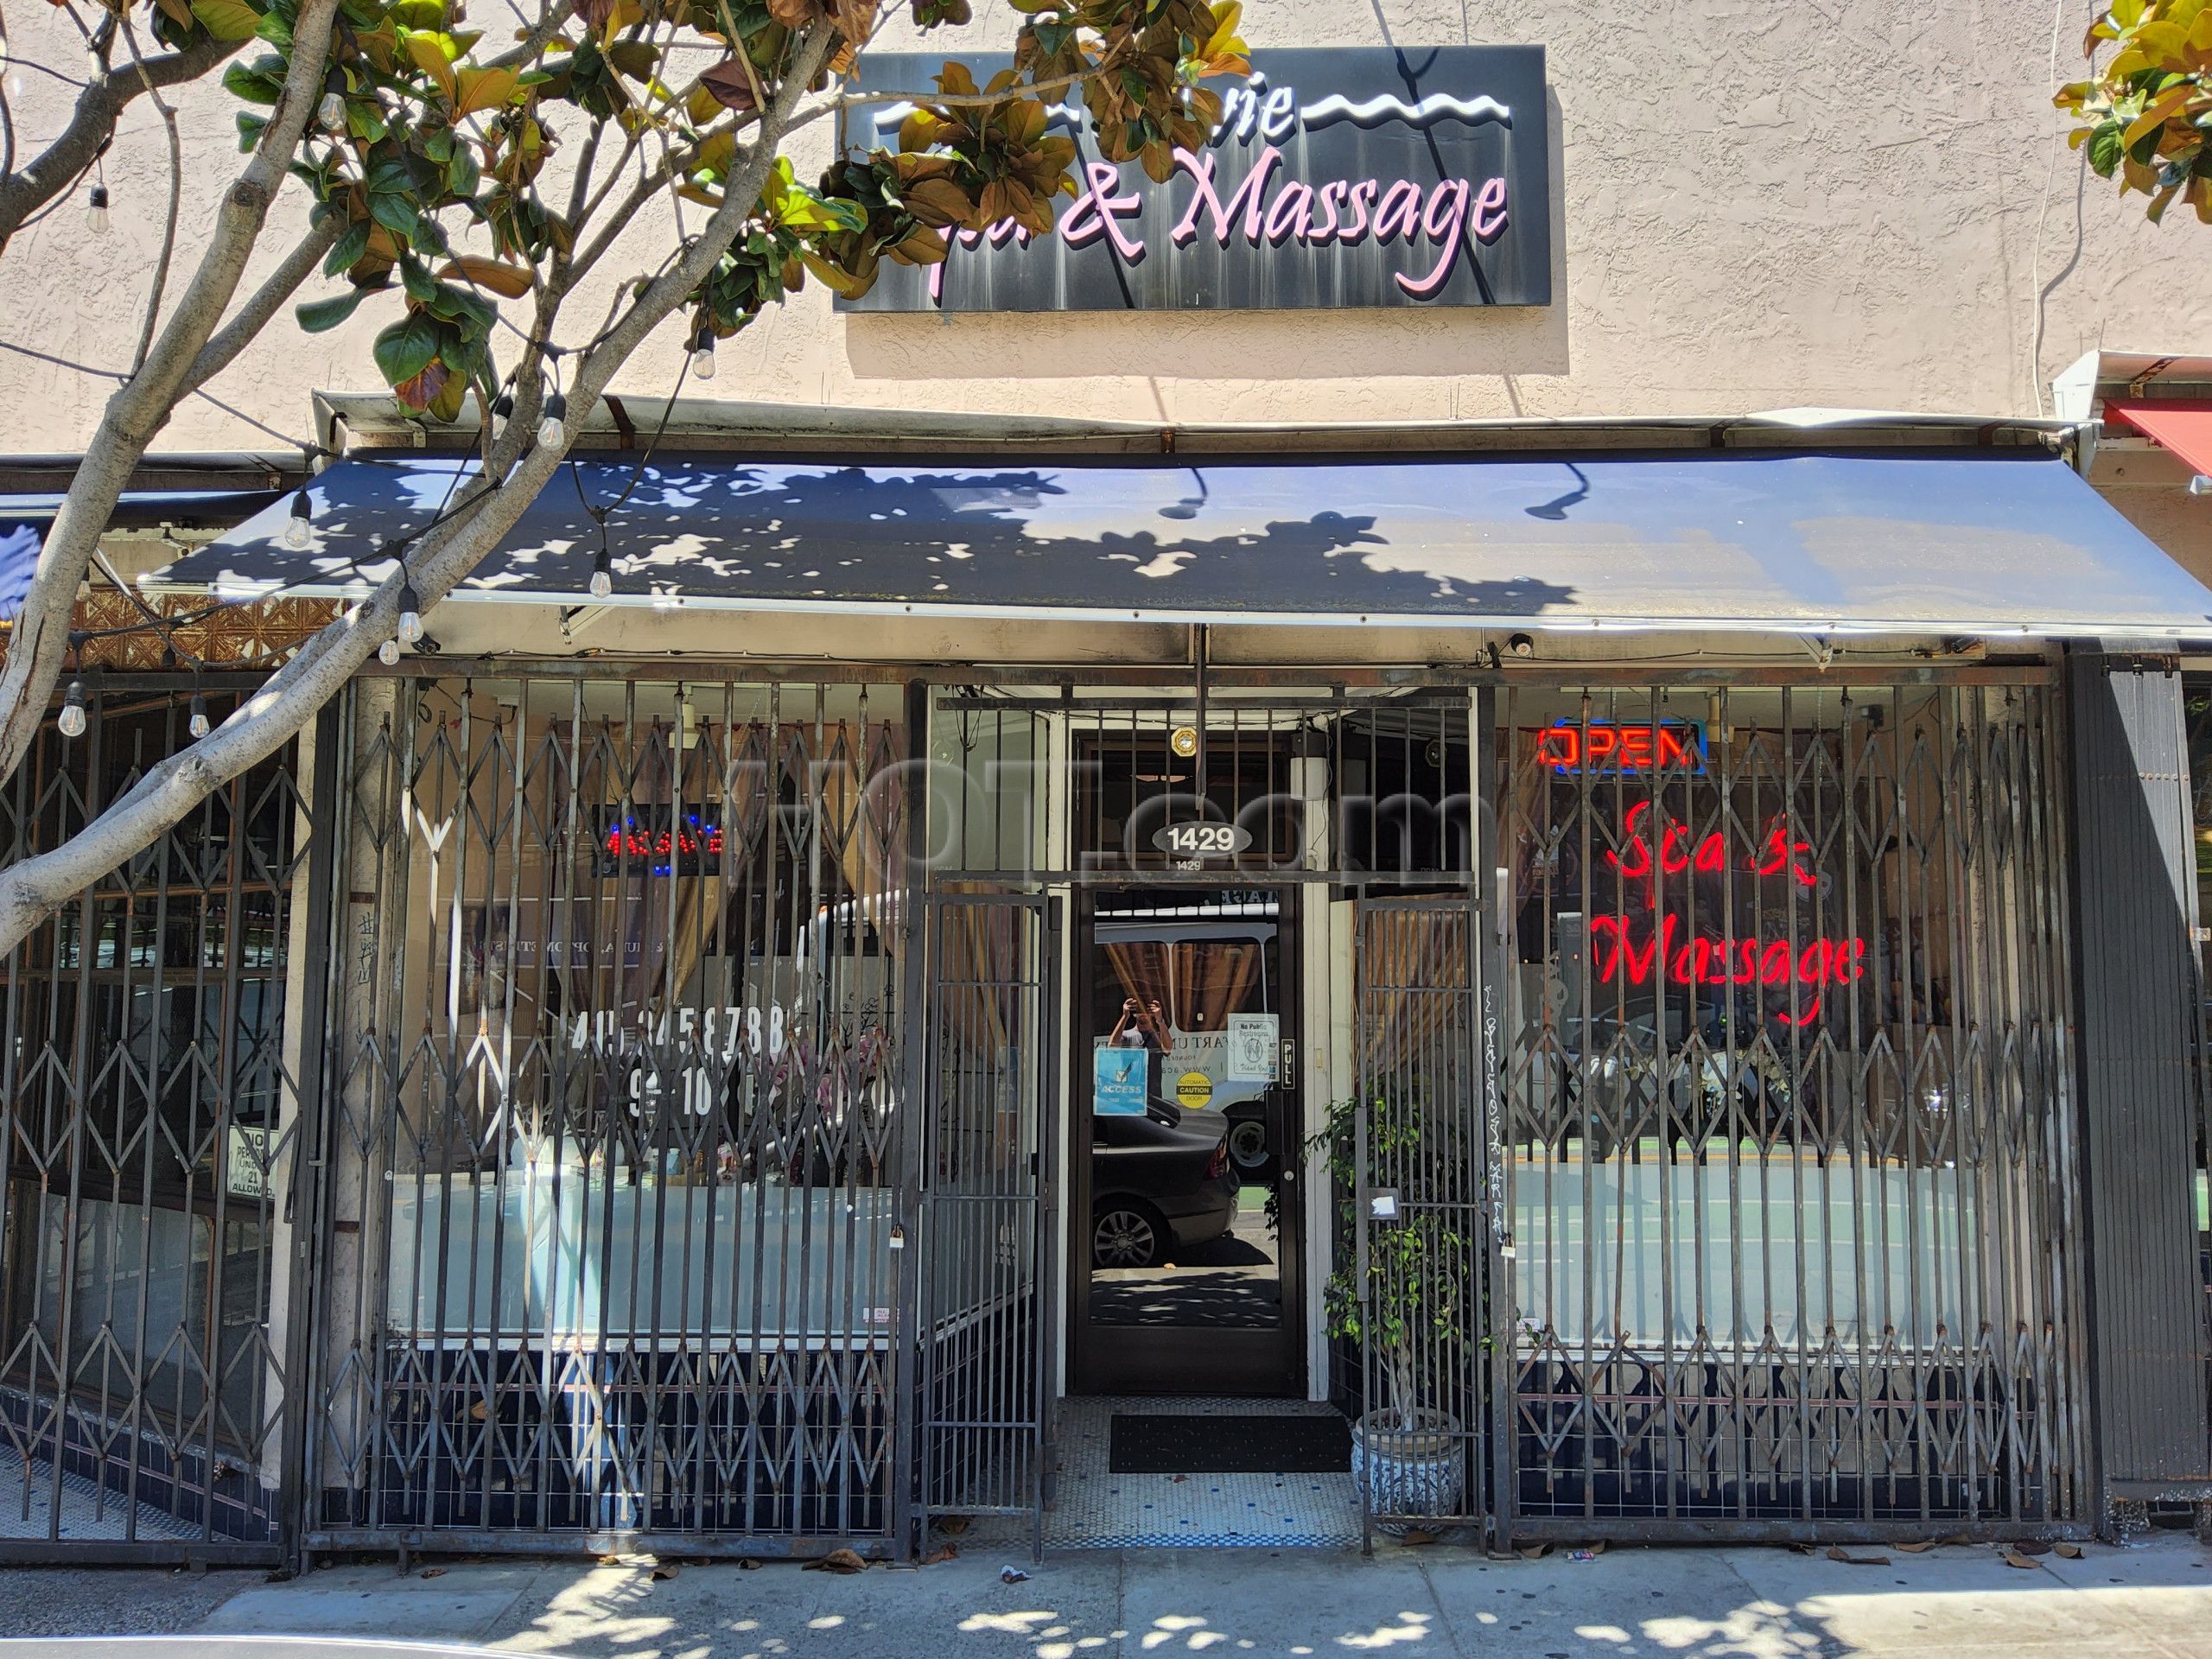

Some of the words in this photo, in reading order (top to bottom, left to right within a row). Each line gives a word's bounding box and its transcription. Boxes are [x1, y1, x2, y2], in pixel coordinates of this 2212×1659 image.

[1059, 162, 1145, 259] &
[1172, 146, 1507, 293] Massage
[1538, 728, 1692, 765] OPEN
[1167, 827, 1235, 851] 1429
[1176, 860, 1201, 871] 1429
[1591, 913, 1863, 1027] Massage
[1101, 1085, 1142, 1094] ACCESS
[248, 1171, 258, 1185] 21
[232, 1183, 276, 1198] ALLOWD.
